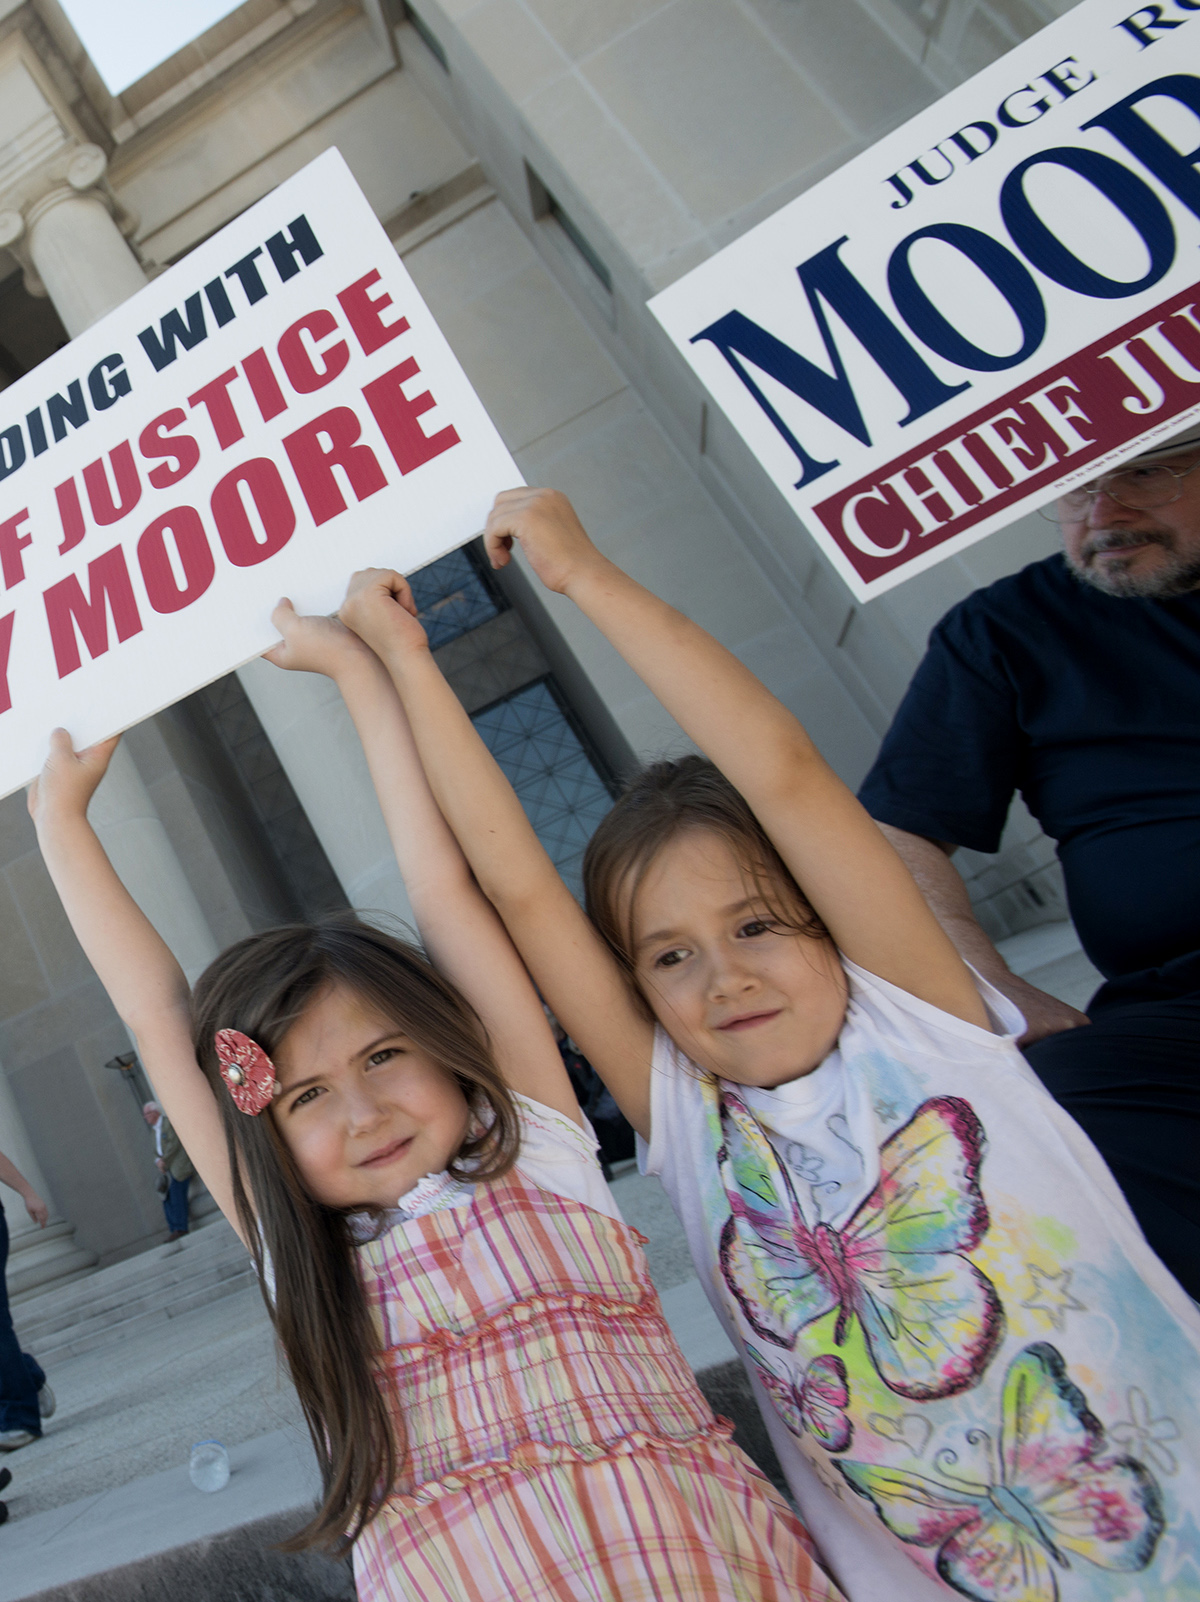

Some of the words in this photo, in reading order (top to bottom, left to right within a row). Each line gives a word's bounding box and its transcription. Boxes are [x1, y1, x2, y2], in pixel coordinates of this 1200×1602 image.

[882, 56, 1098, 210] JUDGE
[136, 213, 326, 373] WITH
[53, 267, 412, 556] JUSTICE
[841, 375, 1098, 558] CHIEF
[42, 355, 463, 680] MOORE
